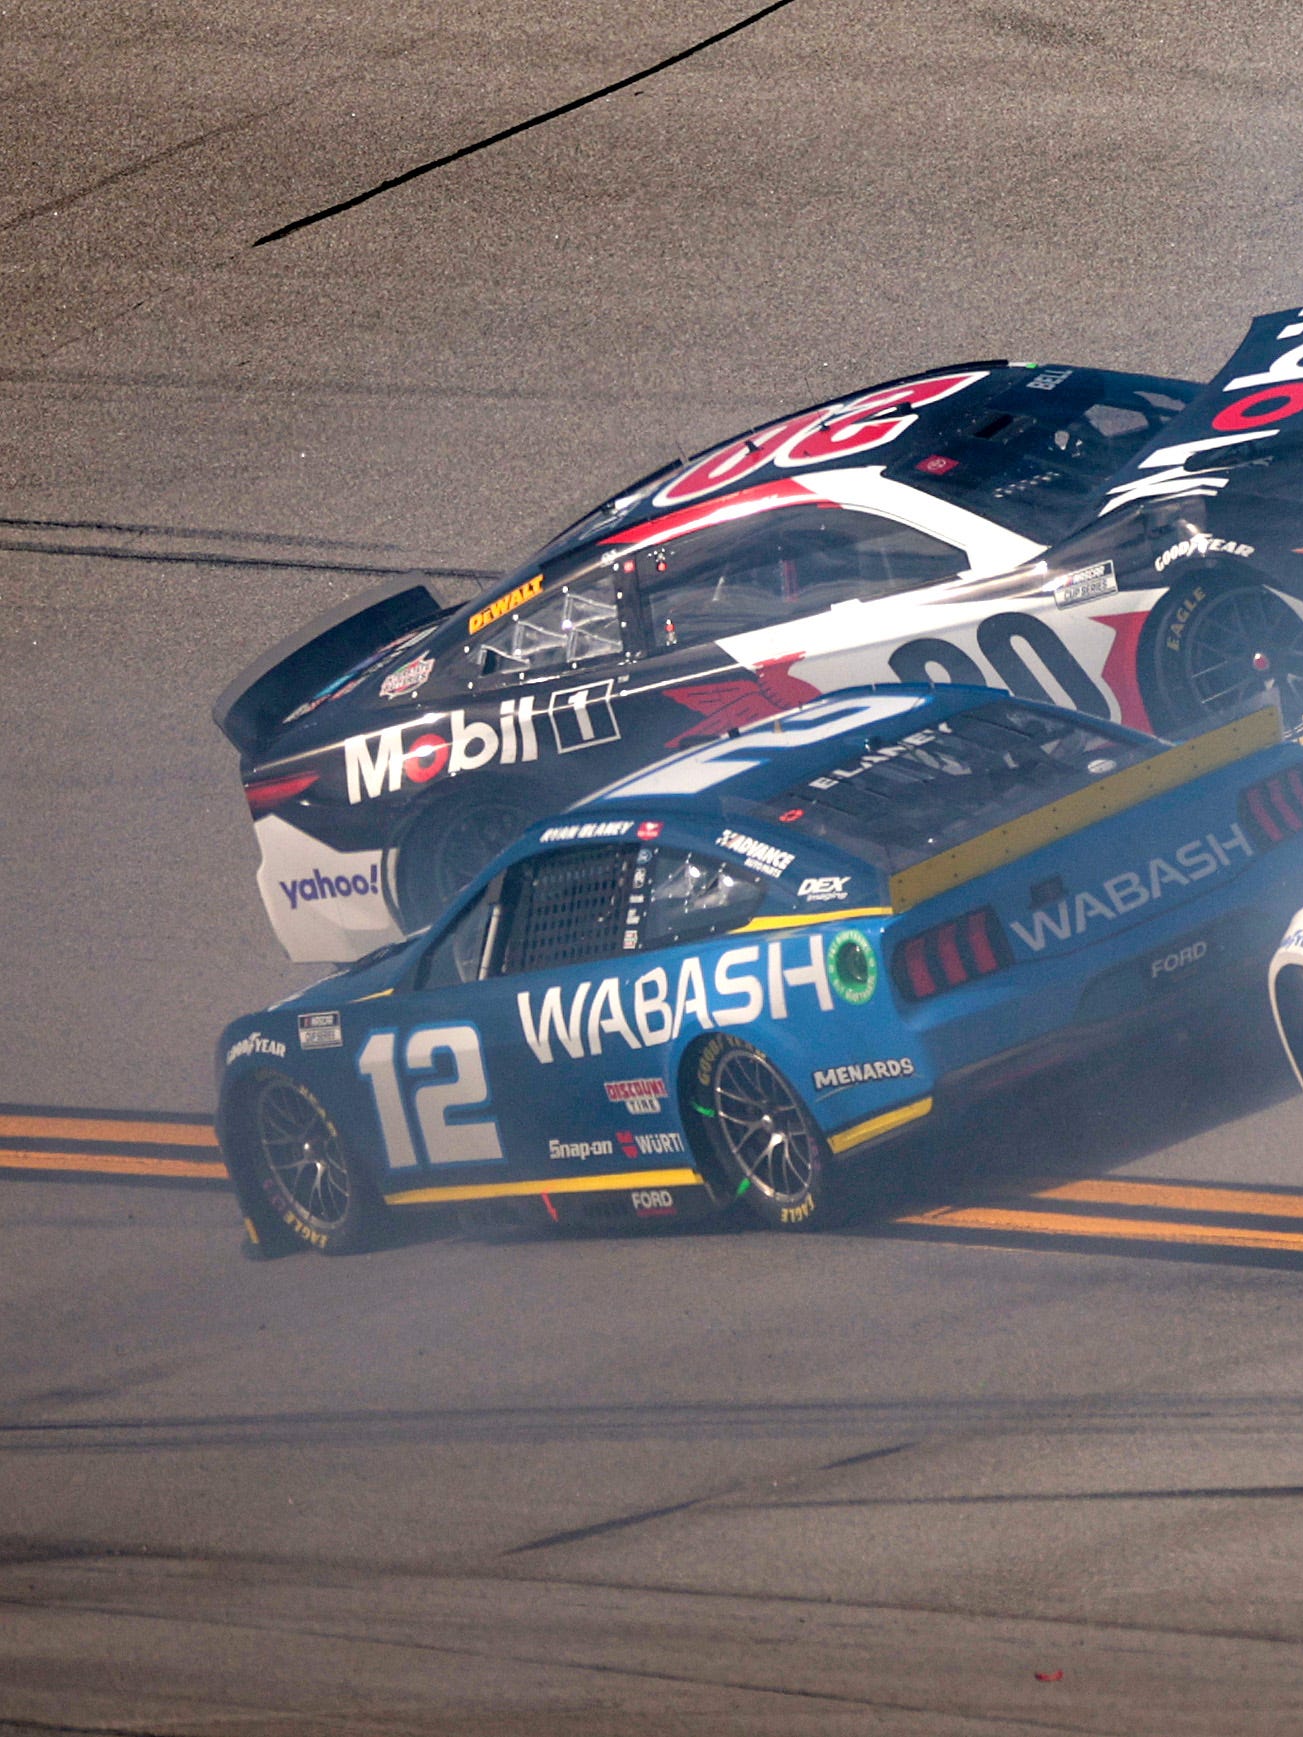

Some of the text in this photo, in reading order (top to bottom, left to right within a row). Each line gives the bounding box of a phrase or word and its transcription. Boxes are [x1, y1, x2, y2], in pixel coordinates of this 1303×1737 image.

[1154, 533, 1255, 572] GOODYEAR
[1166, 587, 1207, 651] EAGLE
[345, 690, 595, 805] Mobil 1
[724, 834, 796, 871] ADVANCE
[279, 864, 379, 910] yahoo!
[797, 876, 851, 896] DEX
[1010, 822, 1255, 951] WABASH
[1151, 941, 1208, 978] FORD
[516, 934, 835, 1064] WABASH
[604, 1078, 668, 1102] DISCOUNT
[813, 1057, 915, 1089] MENARDS
[358, 1024, 503, 1169] 12
[628, 1099, 660, 1114] TIRE
[549, 1139, 613, 1160] Snap-on
[631, 1190, 673, 1209] FORD
